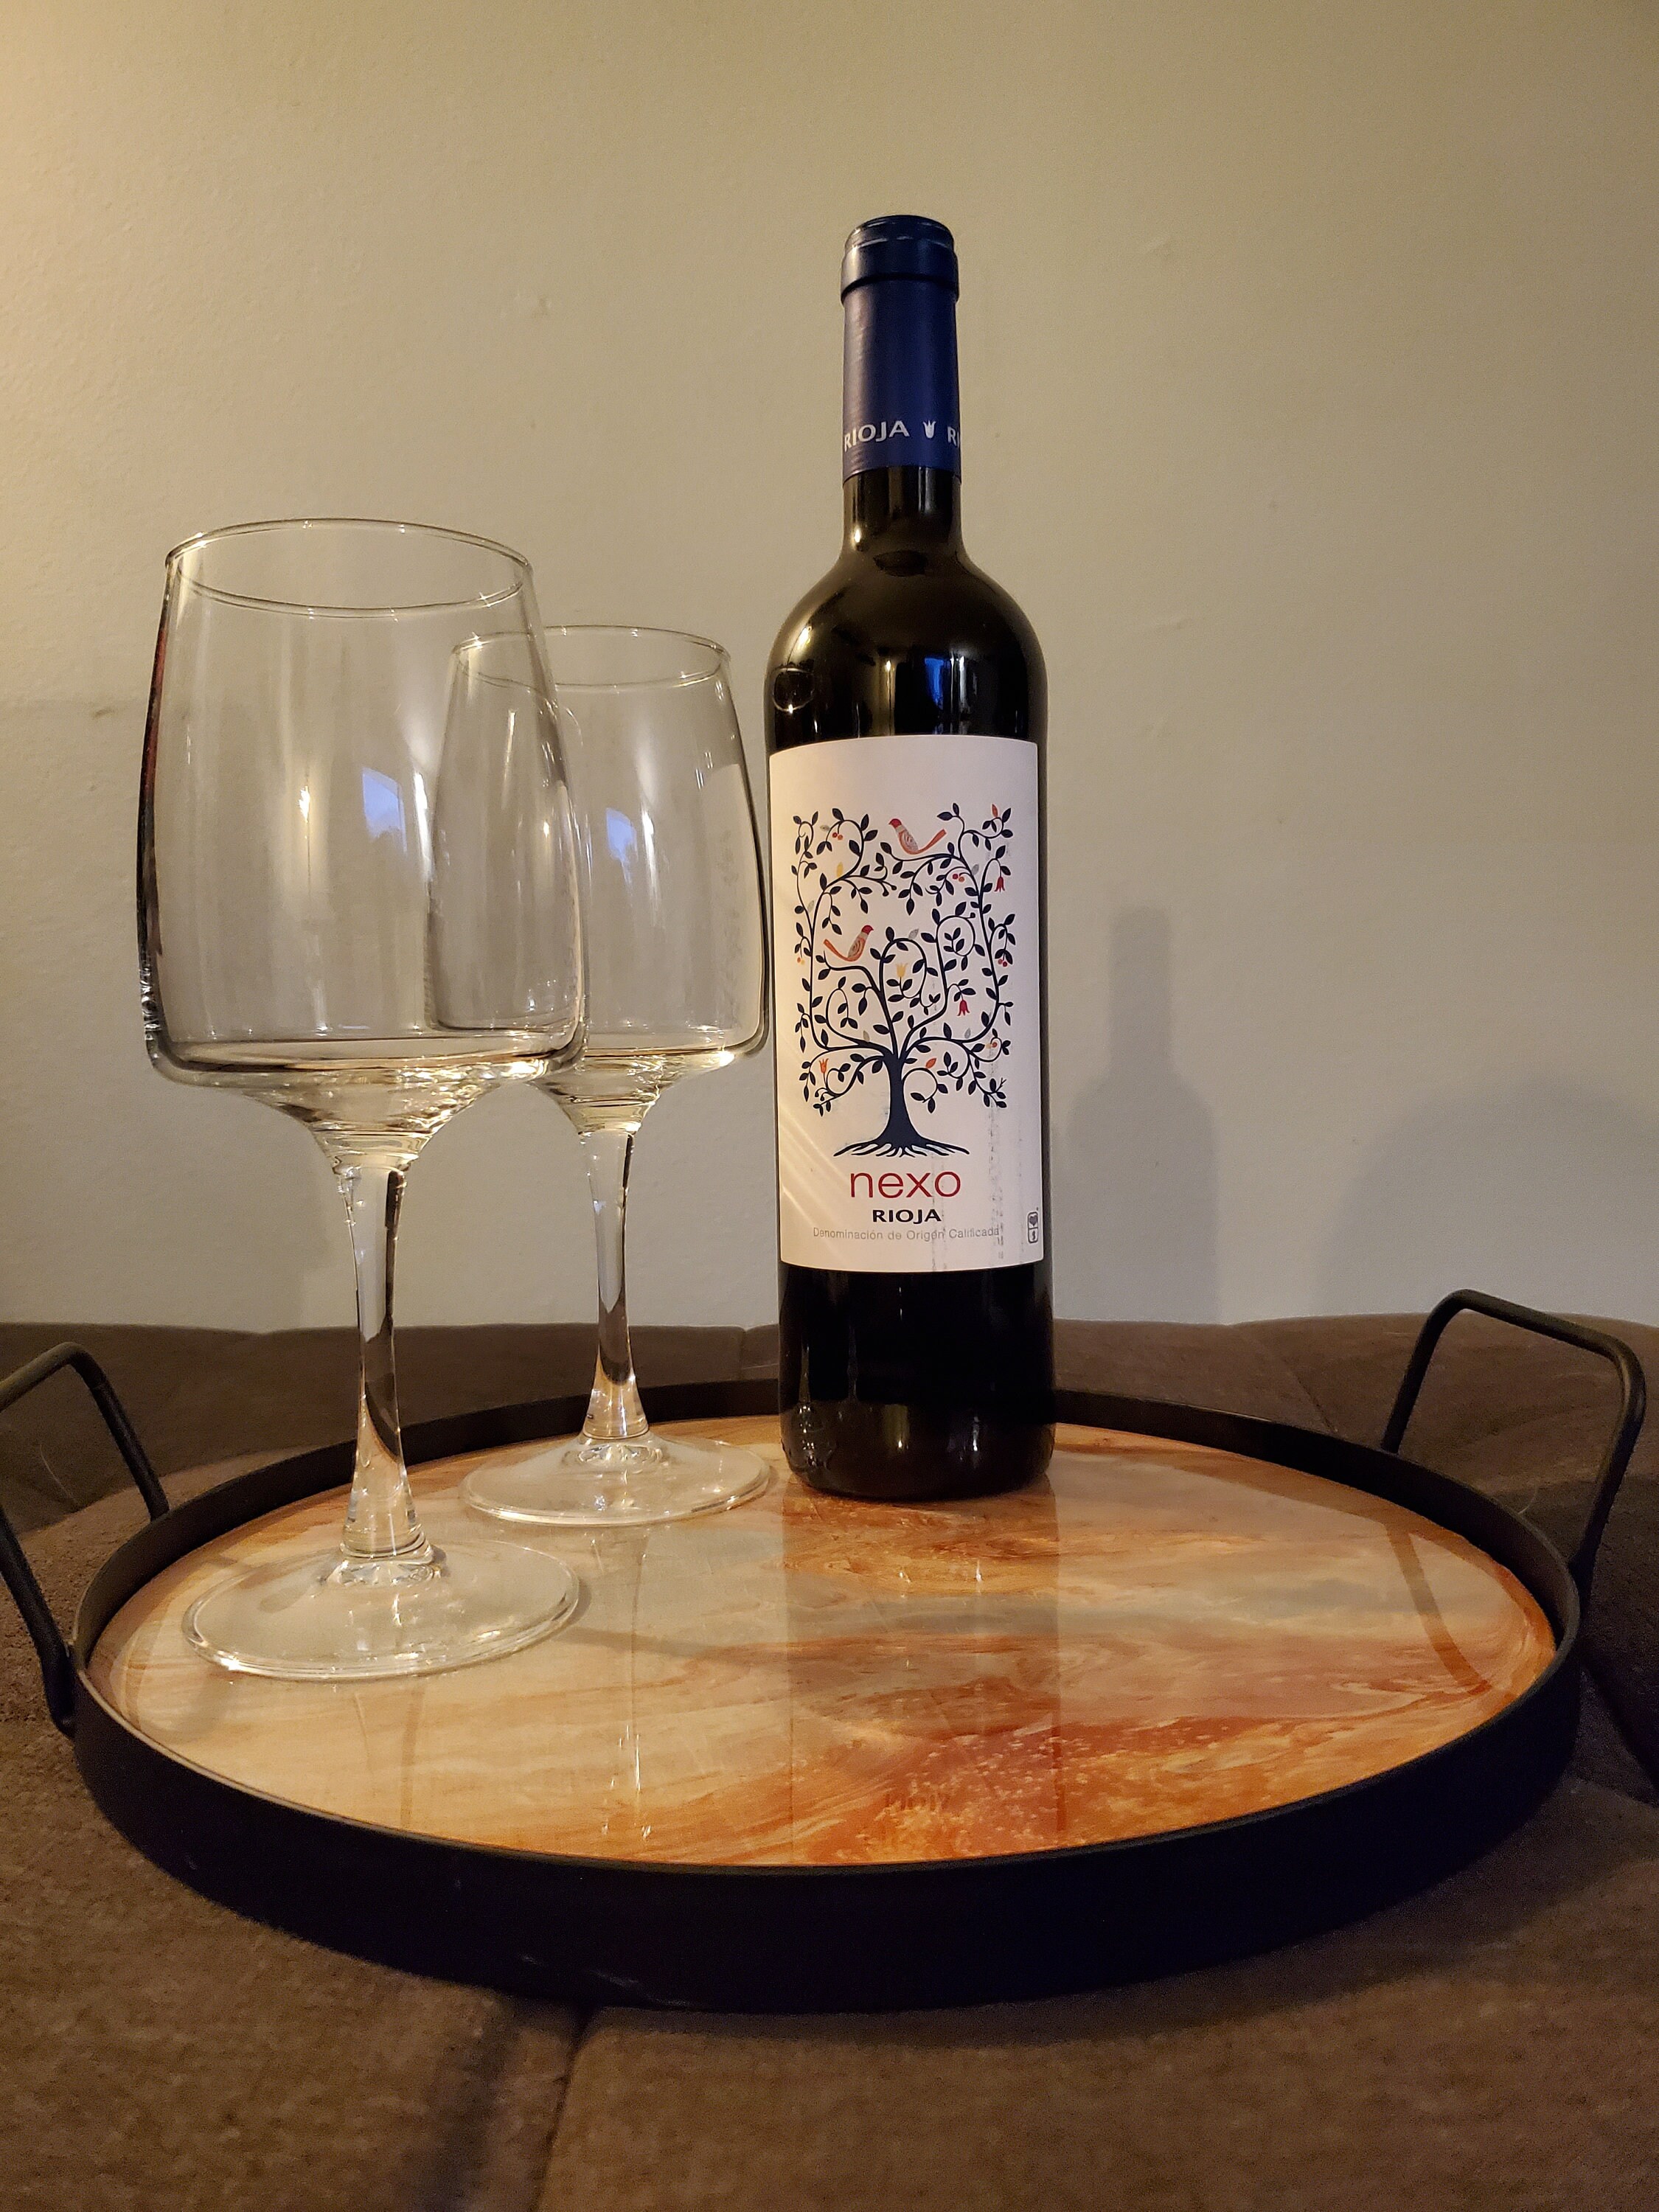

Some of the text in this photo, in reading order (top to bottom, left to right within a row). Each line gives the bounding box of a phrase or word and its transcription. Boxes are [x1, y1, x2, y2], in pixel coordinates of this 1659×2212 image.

[844, 420, 911, 453] RIOJA
[849, 1170, 961, 1199] nexo
[872, 1208, 942, 1225] RIOJA
[813, 1226, 883, 1240] Denominación
[887, 1230, 902, 1240] de
[948, 1225, 1000, 1239] Calificada
